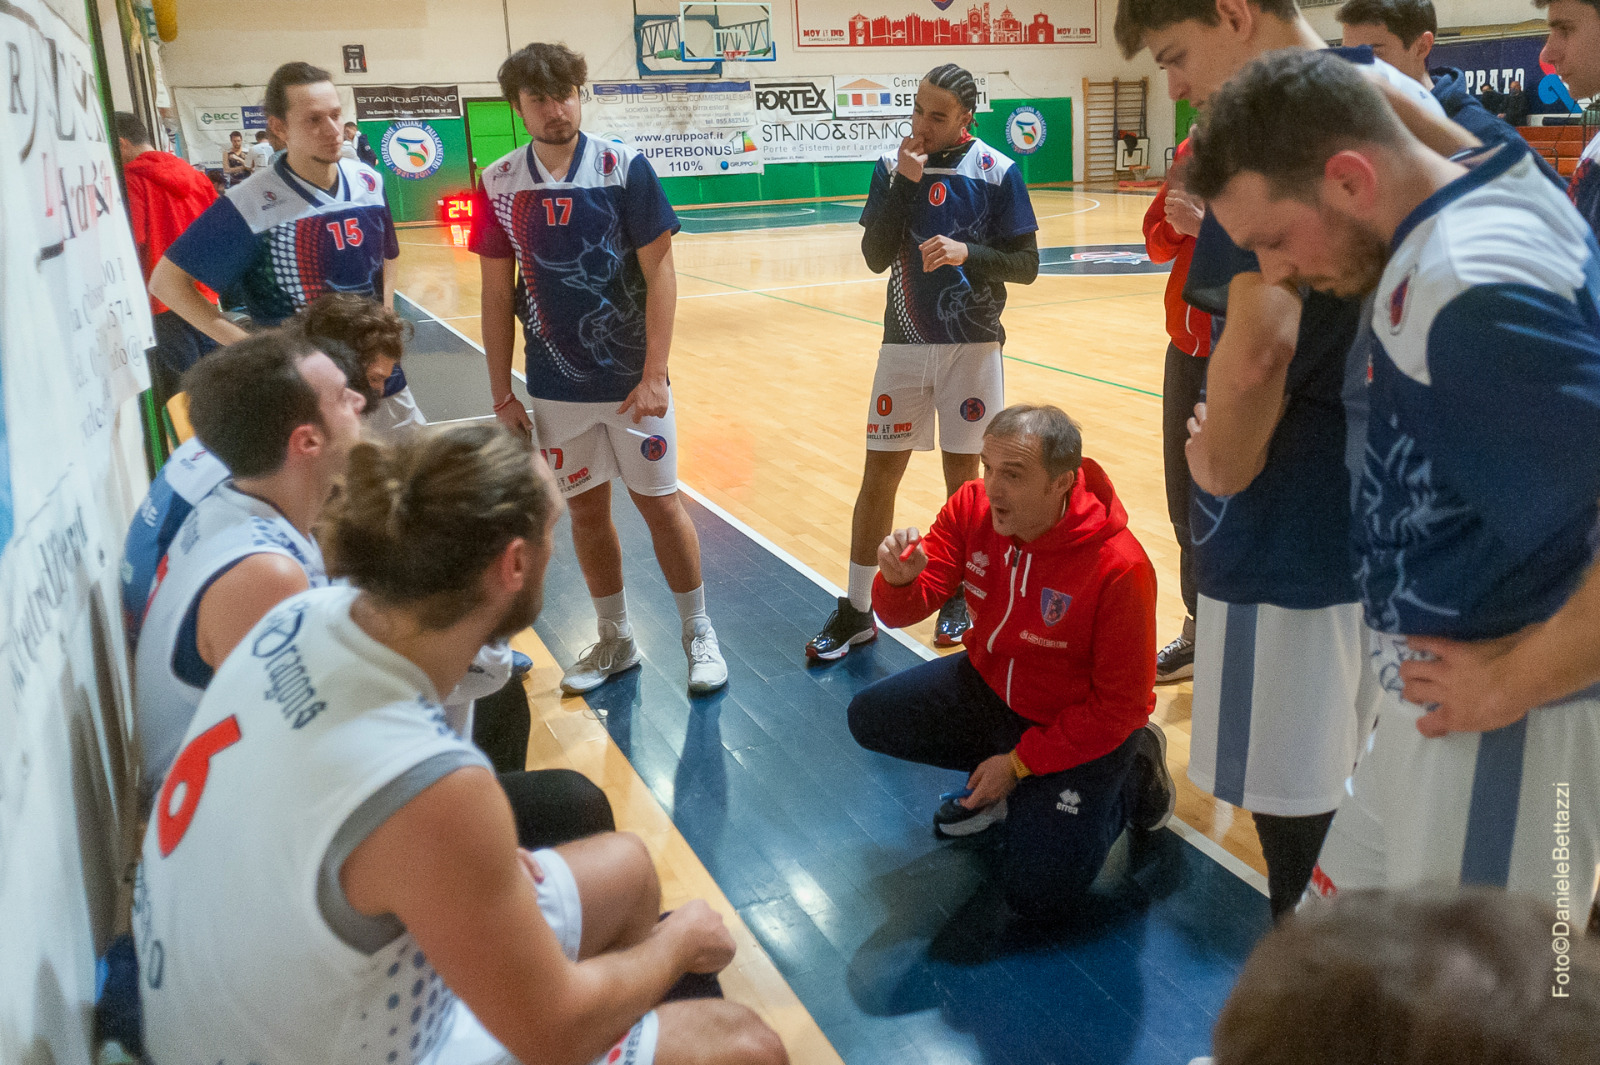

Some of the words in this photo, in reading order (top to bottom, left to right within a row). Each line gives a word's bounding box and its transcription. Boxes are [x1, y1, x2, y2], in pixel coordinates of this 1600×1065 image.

[804, 29, 820, 37] MOV
[830, 29, 844, 37] IND
[348, 58, 361, 70] 11
[634, 131, 724, 144] www.gruppoaf.it
[762, 120, 913, 143] STAINO&STAINO
[381, 126, 395, 167] FEDERAZIONE
[395, 120, 423, 129] ITALIANA
[424, 125, 444, 170] PALLACANESTRO
[799, 143, 833, 152] Sistemi
[836, 144, 850, 152] per
[669, 160, 703, 172] 110%
[929, 182, 947, 206] 0
[448, 199, 473, 218] 24
[542, 198, 573, 226] 17
[327, 218, 364, 250] 15
[876, 394, 893, 416] 0
[568, 466, 589, 484] IND
